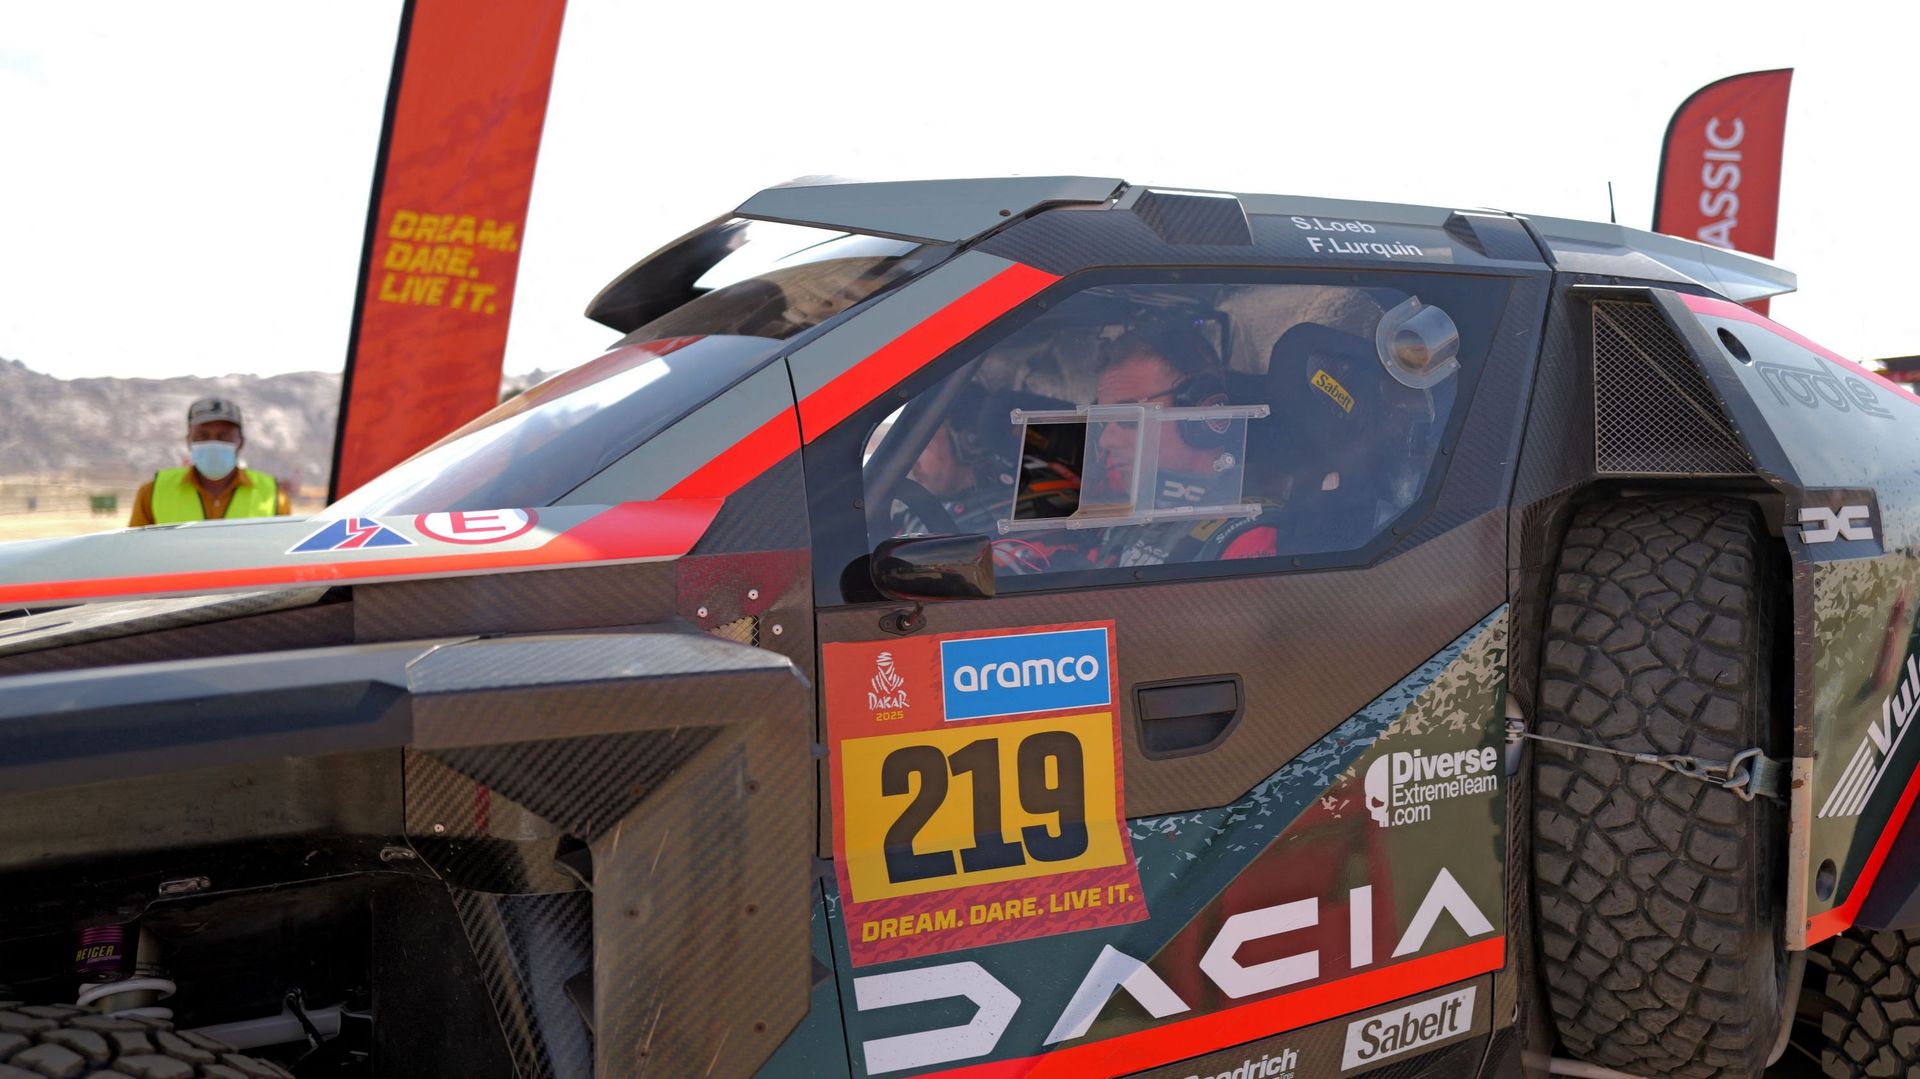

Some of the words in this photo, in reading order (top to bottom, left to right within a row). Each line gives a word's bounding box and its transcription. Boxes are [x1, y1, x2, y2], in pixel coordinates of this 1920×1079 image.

[1698, 116, 1745, 250] ASSIC
[388, 209, 518, 252] DREAM.
[1290, 216, 1377, 234] S.Loeb
[384, 241, 479, 279] DARE.
[1306, 236, 1424, 258] F.Lurquin
[379, 272, 448, 306] LIVE
[451, 281, 497, 315] IT.
[1316, 374, 1351, 409] Sabelt
[953, 655, 1099, 692] aramco
[868, 690, 910, 711] DAKAR
[875, 710, 904, 721] 2025
[1867, 653, 1920, 757] Vul
[1392, 746, 1498, 785] Diverse
[881, 730, 1089, 884] 219
[1392, 774, 1498, 807] ExtremeTeam
[1391, 804, 1431, 827] .com
[861, 908, 964, 943] DREAM.
[970, 896, 1044, 925] DARE.
[1049, 888, 1102, 914] LIVE
[1107, 883, 1135, 905] IT.
[75, 945, 115, 962] REIGER
[853, 867, 1495, 1075] DACIA
[1357, 997, 1462, 1060] Sabelt
